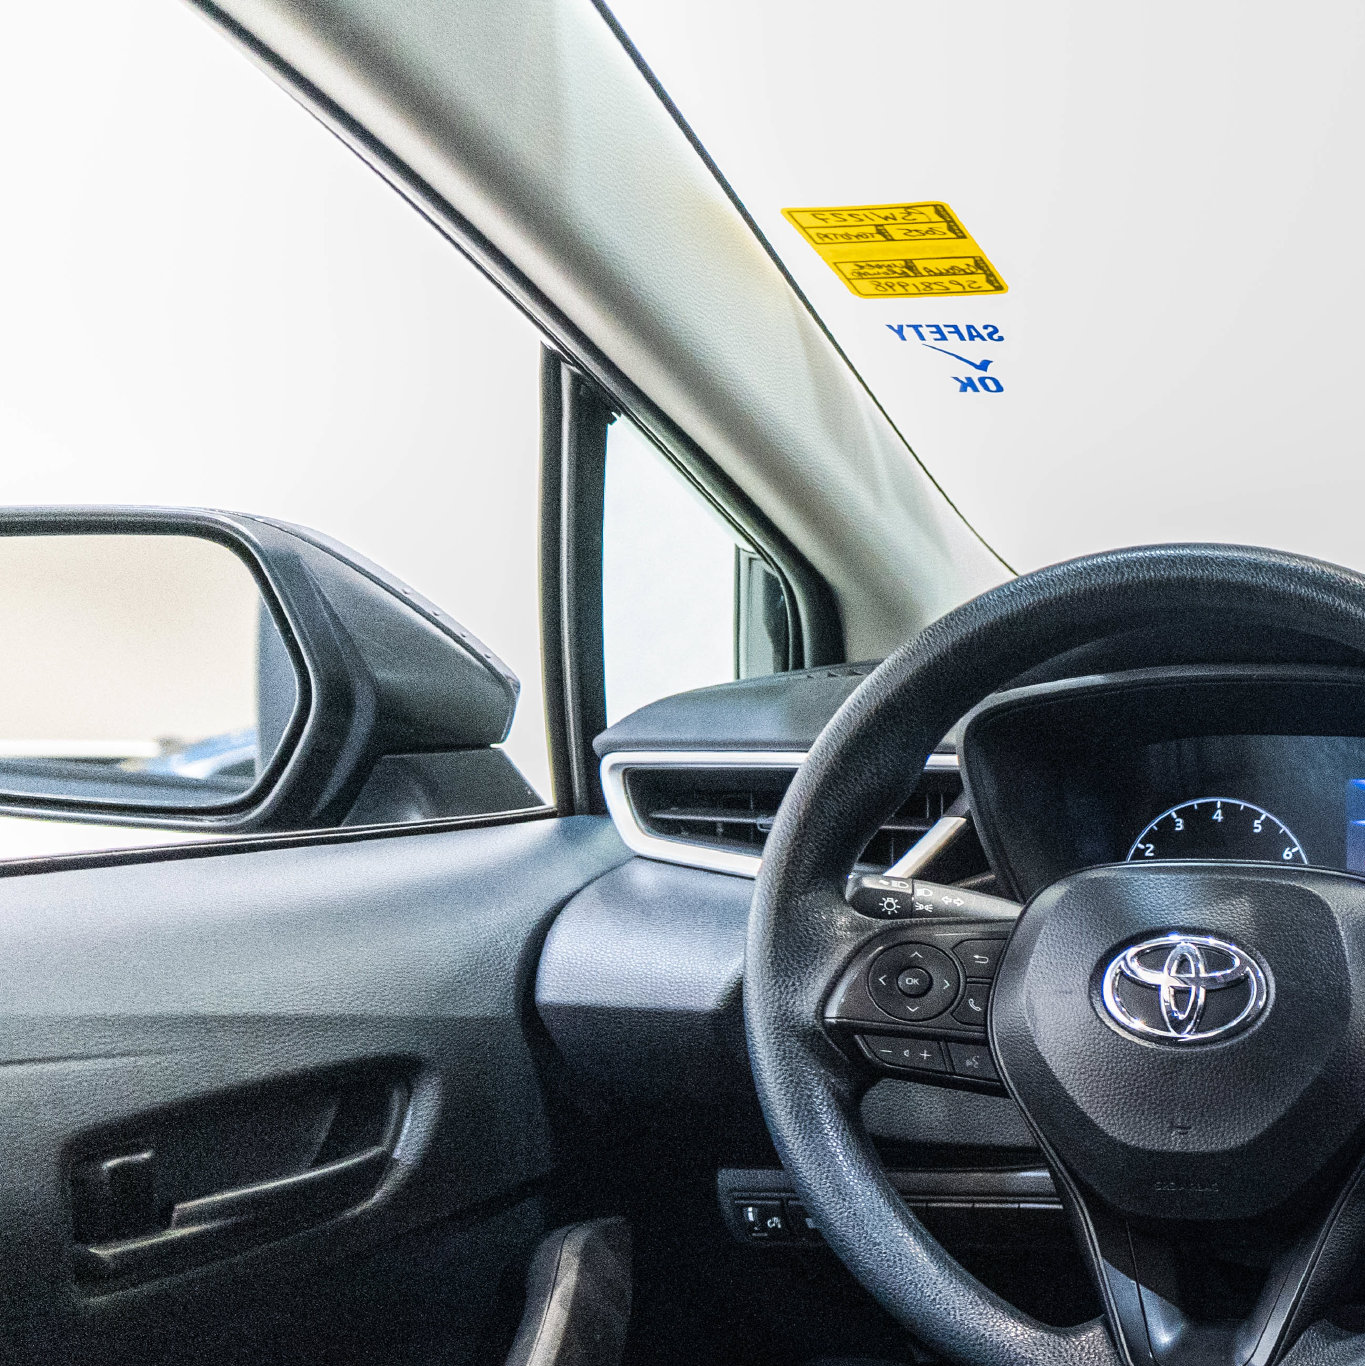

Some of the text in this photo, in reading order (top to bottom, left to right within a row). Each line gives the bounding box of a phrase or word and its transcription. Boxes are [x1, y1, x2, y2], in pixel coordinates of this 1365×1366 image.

[1212, 809, 1223, 822] 4
[1175, 818, 1184, 831] 3
[1253, 820, 1262, 833] 5
[1145, 844, 1154, 856] 2
[1283, 847, 1292, 860] 6
